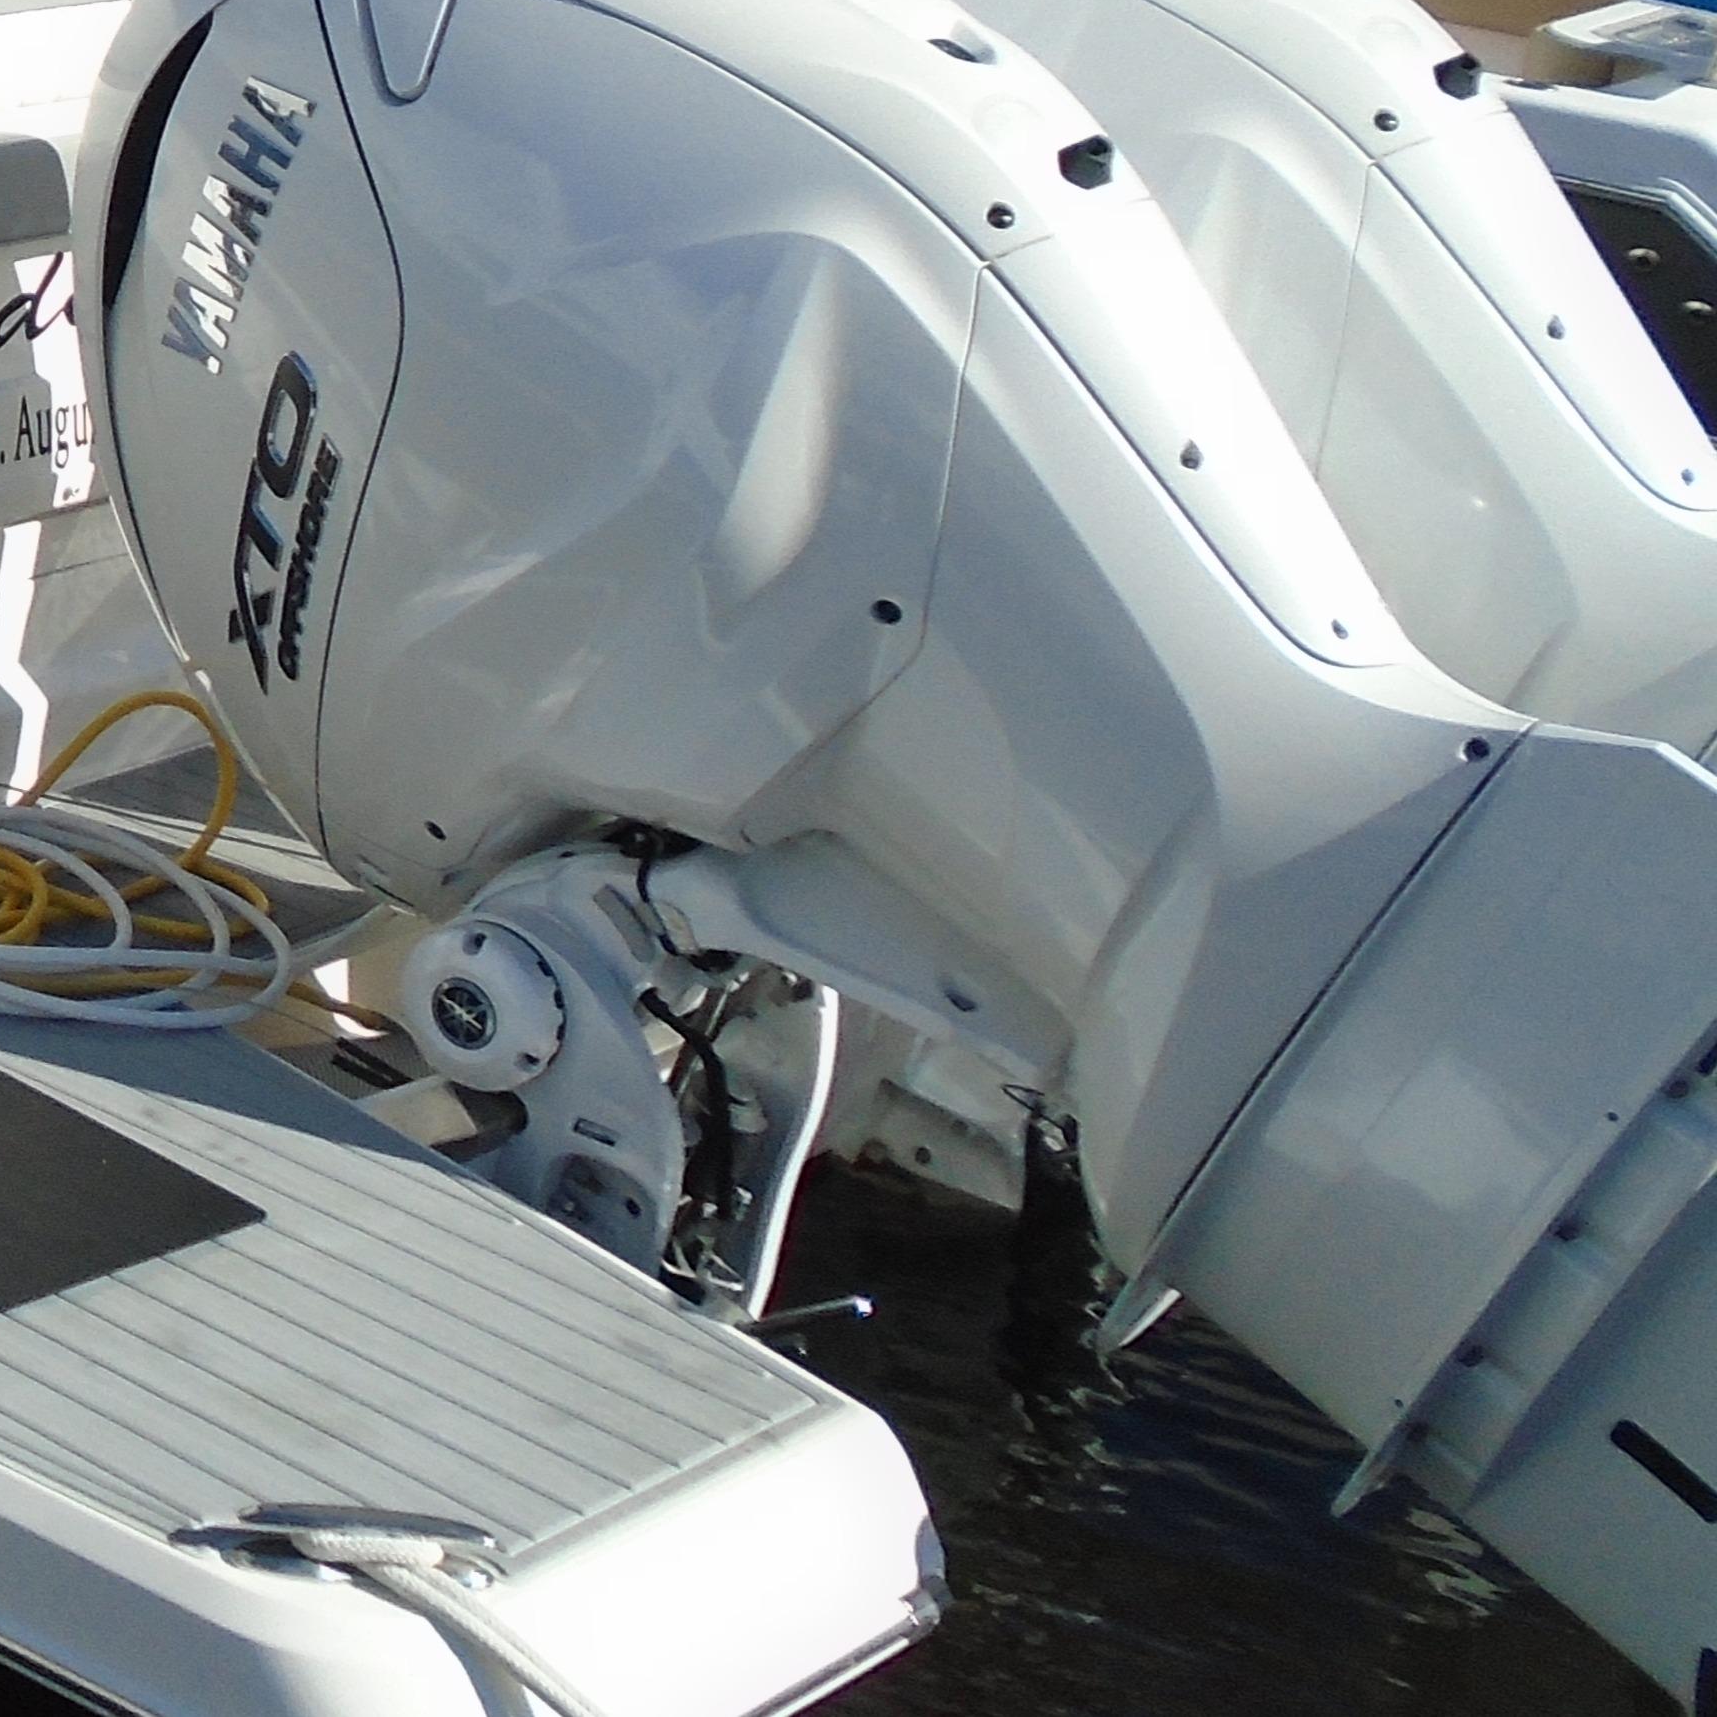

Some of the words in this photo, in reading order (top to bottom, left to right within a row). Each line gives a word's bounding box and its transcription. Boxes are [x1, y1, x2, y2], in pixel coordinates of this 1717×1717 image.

[162, 75, 317, 375] YAMAHA
[15, 395, 96, 469] Augu
[228, 351, 317, 696] XTO
